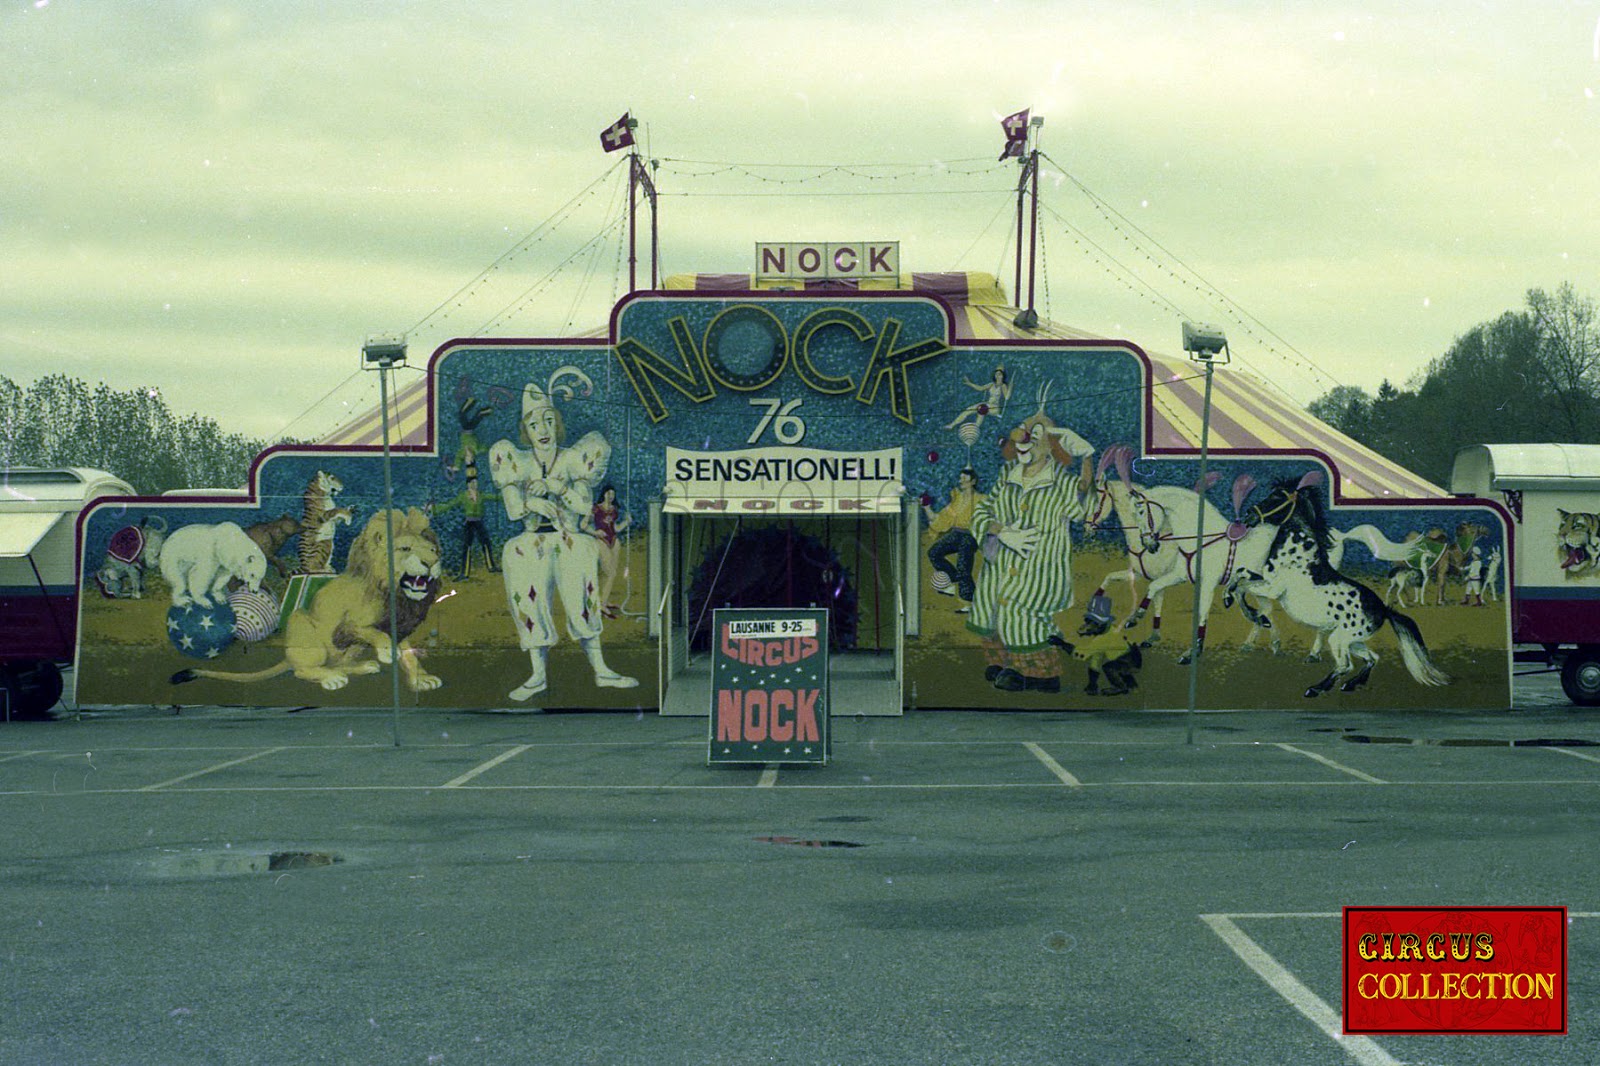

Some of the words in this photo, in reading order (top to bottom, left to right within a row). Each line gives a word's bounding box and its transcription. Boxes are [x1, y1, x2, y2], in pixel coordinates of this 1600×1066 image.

[762, 247, 893, 273] NOCK
[614, 304, 951, 424] NOCK
[747, 398, 806, 445] 76
[674, 458, 897, 482] SENSATIONELL!
[693, 499, 876, 511] NOCK
[731, 622, 776, 634] LAUSANNE
[781, 621, 803, 632] 9-25
[717, 689, 820, 742] NOCK
